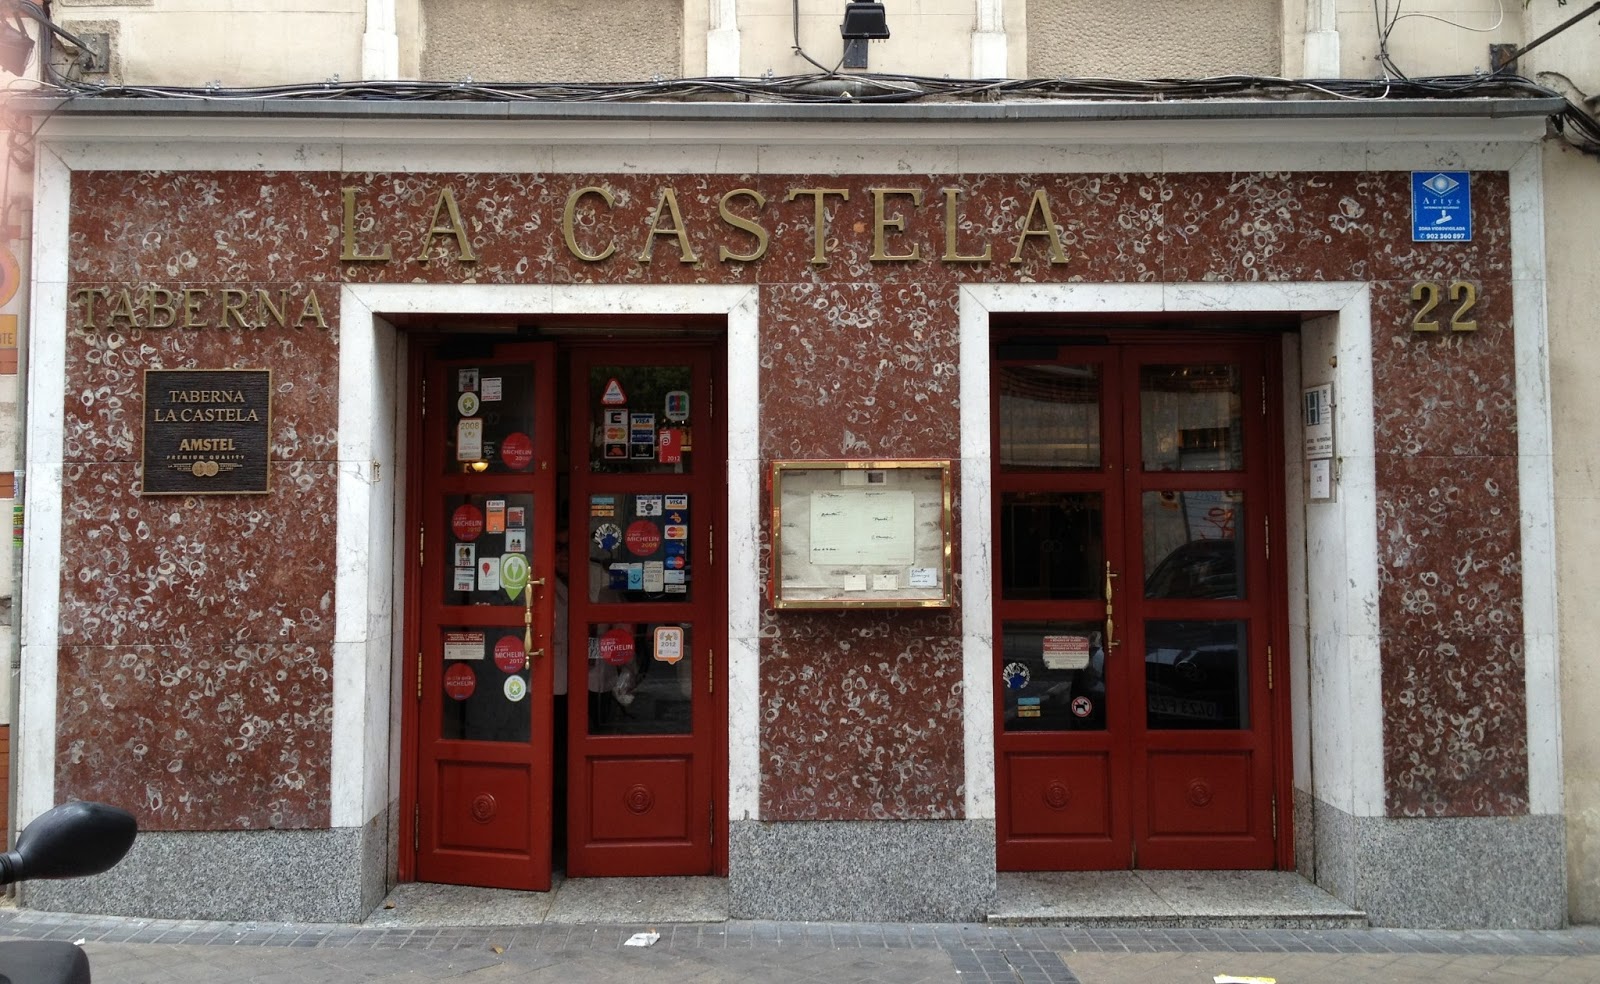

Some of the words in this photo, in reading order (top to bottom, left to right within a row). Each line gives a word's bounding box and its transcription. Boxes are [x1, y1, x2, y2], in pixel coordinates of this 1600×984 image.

[1423, 197, 1460, 206] Artys
[339, 186, 476, 262] LA
[563, 186, 1070, 264] CASTELA
[77, 288, 328, 330] TABERNA
[1412, 281, 1478, 332] 22
[168, 390, 246, 403] TABERNA
[154, 409, 178, 422] LA
[180, 408, 259, 422] CASTELA
[460, 422, 480, 430] 2008
[179, 438, 236, 452] AMSTEL
[600, 644, 633, 652] MICHELIN
[495, 651, 524, 659] MICHELIN
